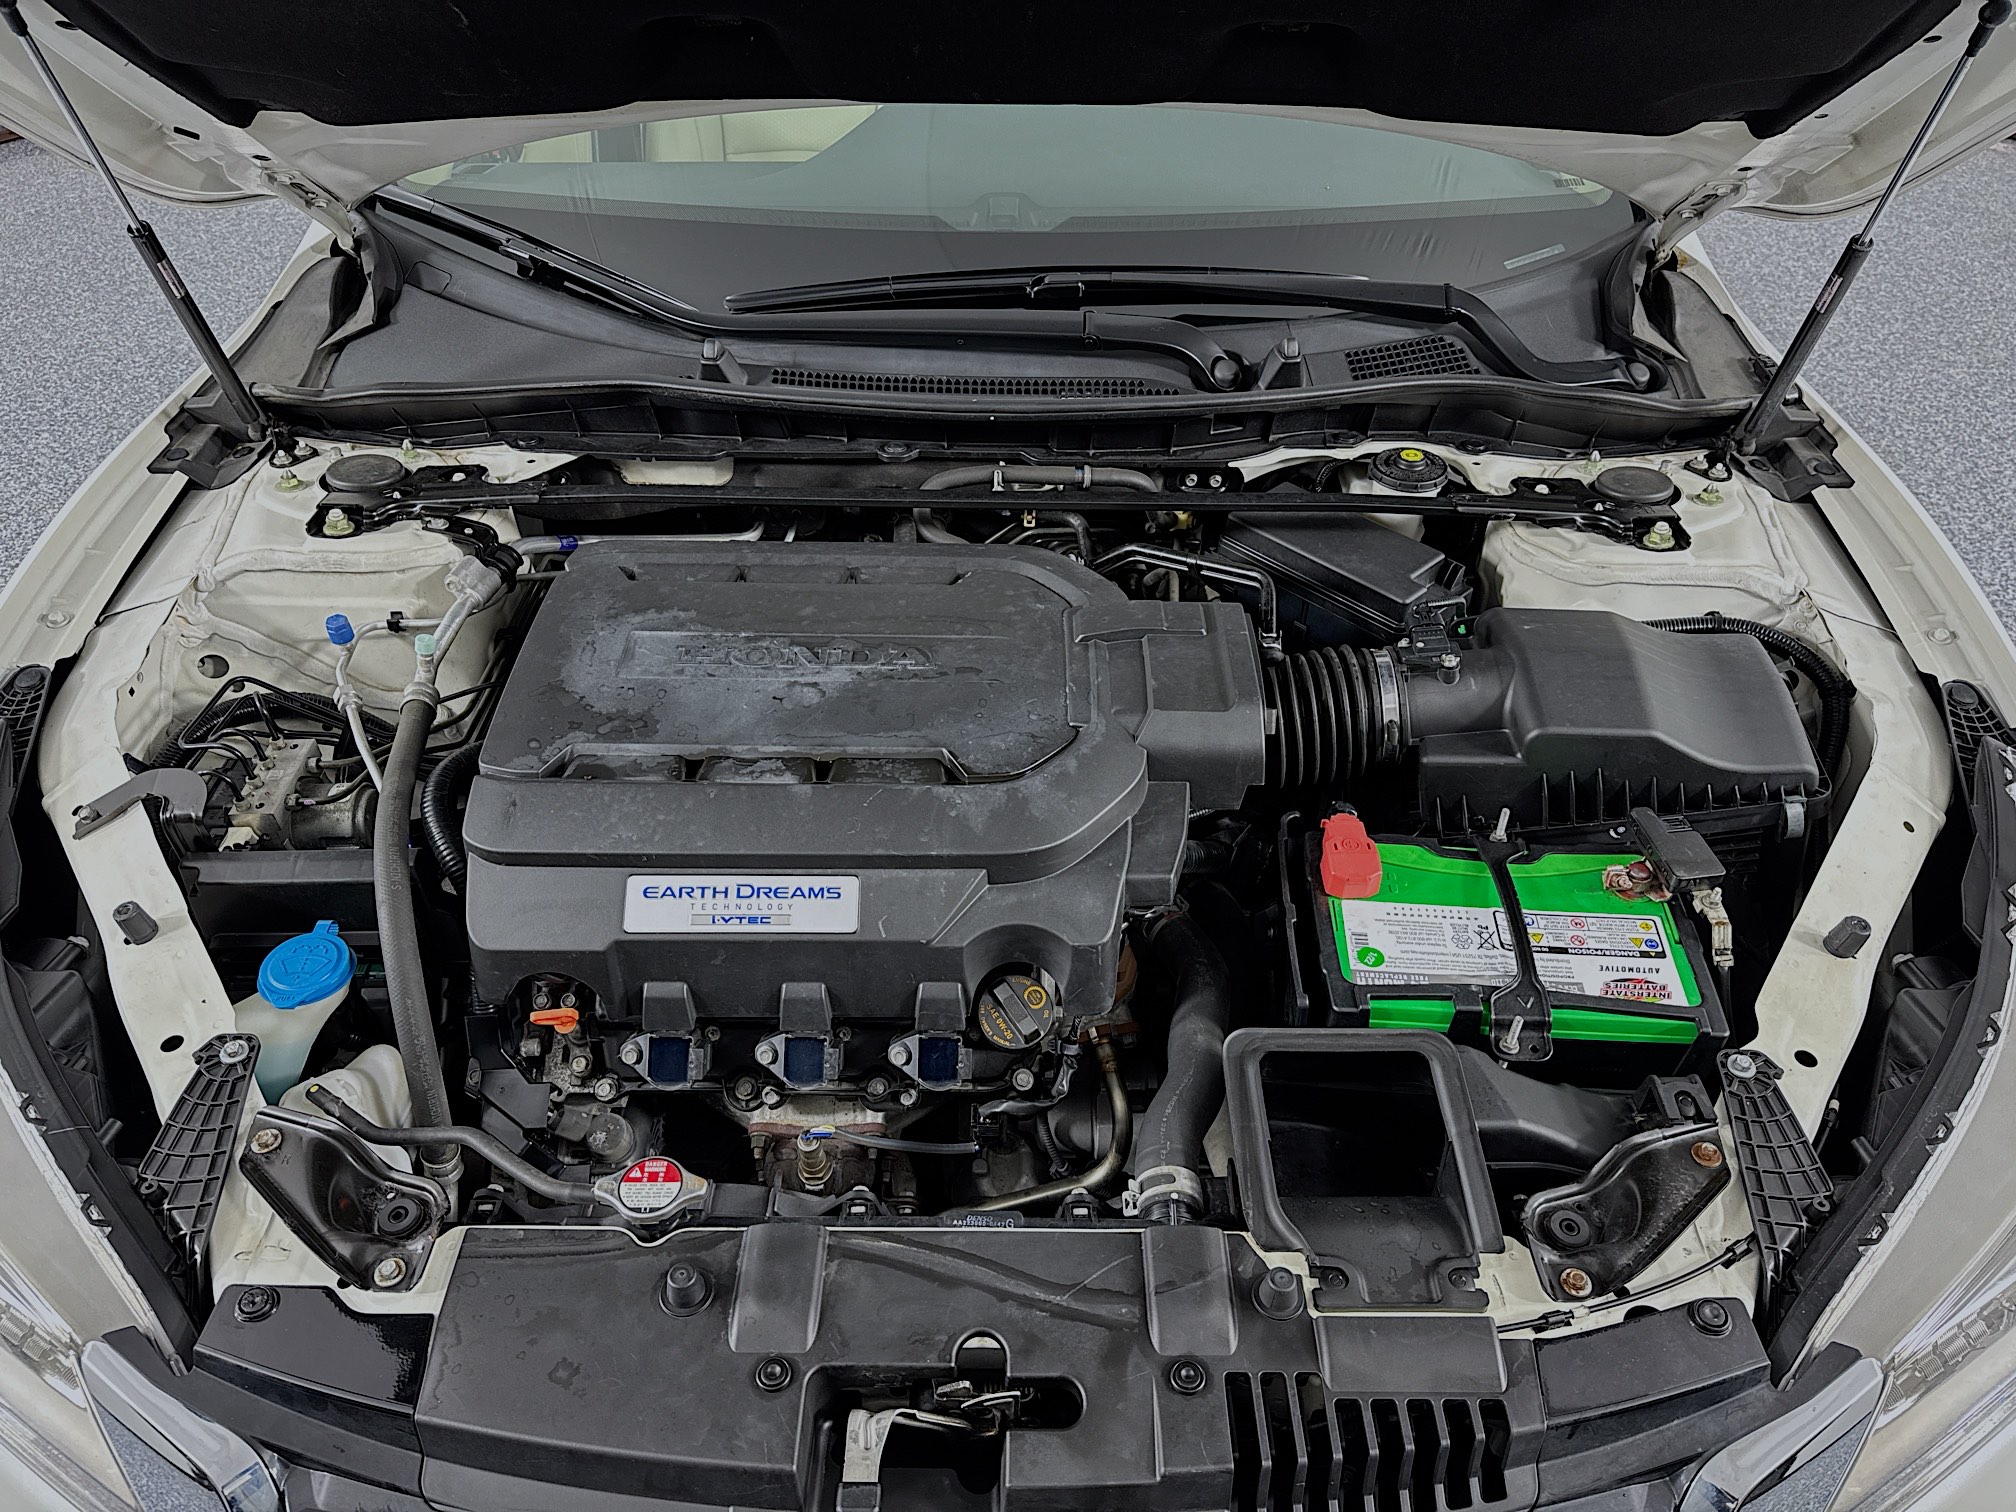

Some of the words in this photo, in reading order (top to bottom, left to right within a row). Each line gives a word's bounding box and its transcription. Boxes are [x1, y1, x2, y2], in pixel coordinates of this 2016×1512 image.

[677, 644, 940, 669] HONDA
[643, 886, 728, 899] EARTH
[736, 884, 842, 899] DREAMS
[690, 903, 794, 911] TECHNOLOGY
[1568, 948, 1640, 957] DANGER/POISON
[1363, 952, 1377, 965] 1/22
[1598, 965, 1660, 974] AUTOMOTIVE
[1012, 976, 1032, 986] ENGINE
[1604, 982, 1666, 991] BATTERIES
[1602, 990, 1670, 999] INTERSTATE
[986, 1004, 1000, 1019] SAE
[996, 1018, 1013, 1040] 0W-20
